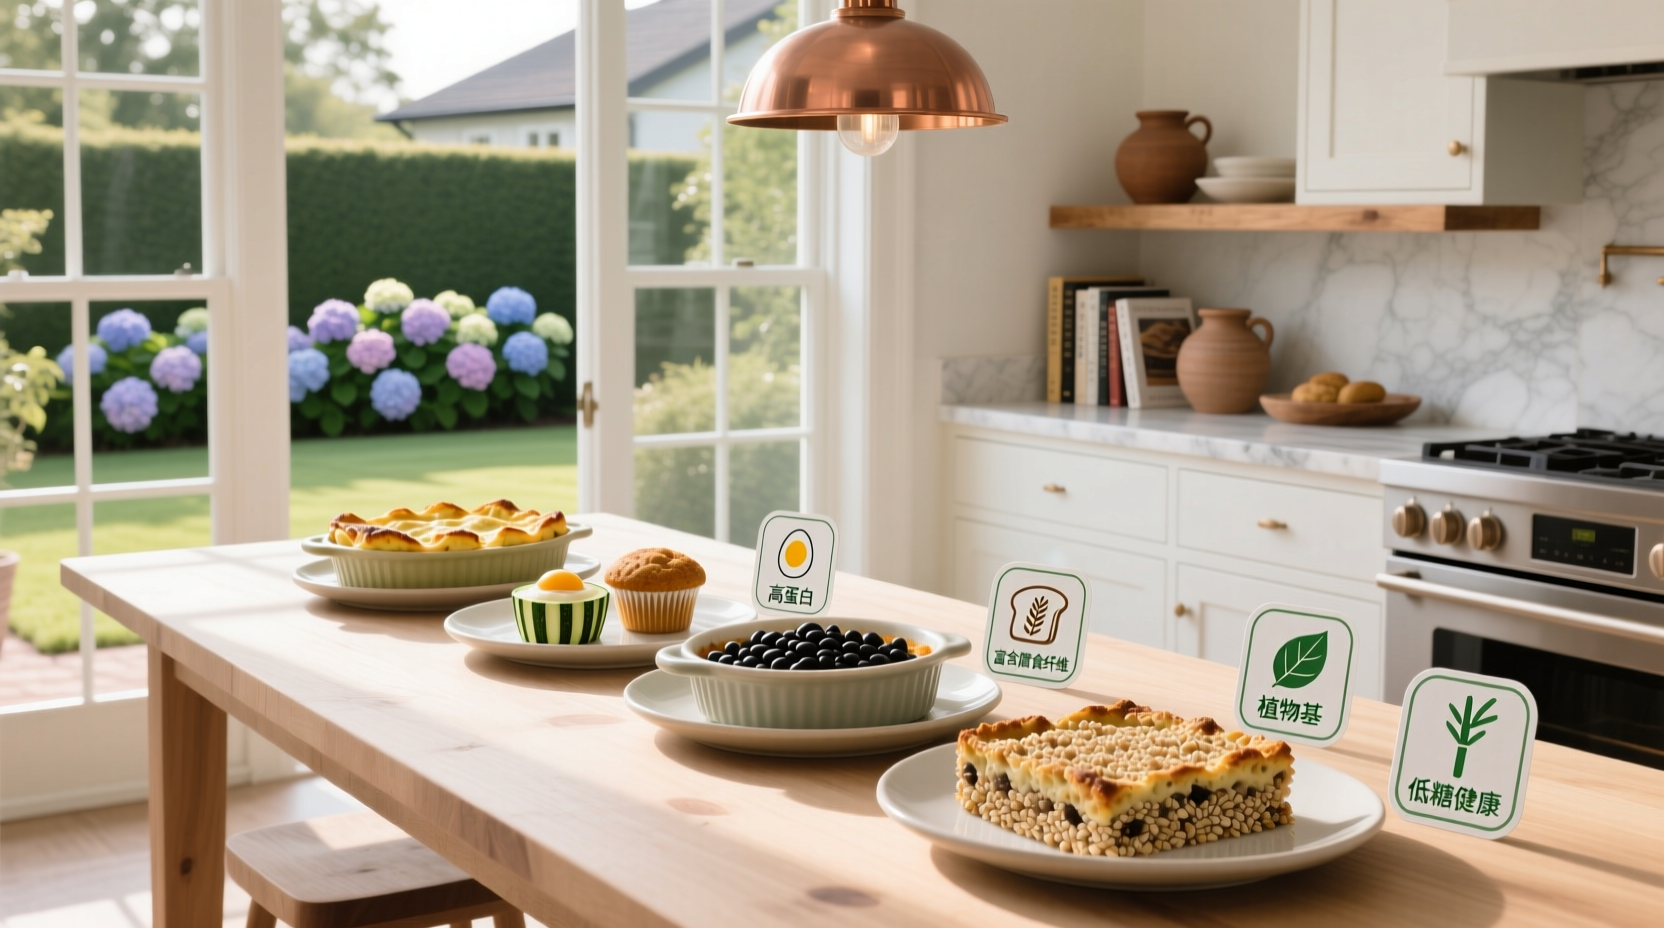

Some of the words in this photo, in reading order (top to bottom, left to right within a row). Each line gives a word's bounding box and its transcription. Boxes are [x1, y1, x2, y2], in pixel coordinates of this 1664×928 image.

[768, 583, 813, 606] 高蛋白
[1258, 695, 1323, 726] 植物基
[1408, 777, 1502, 817] 低糖健康
